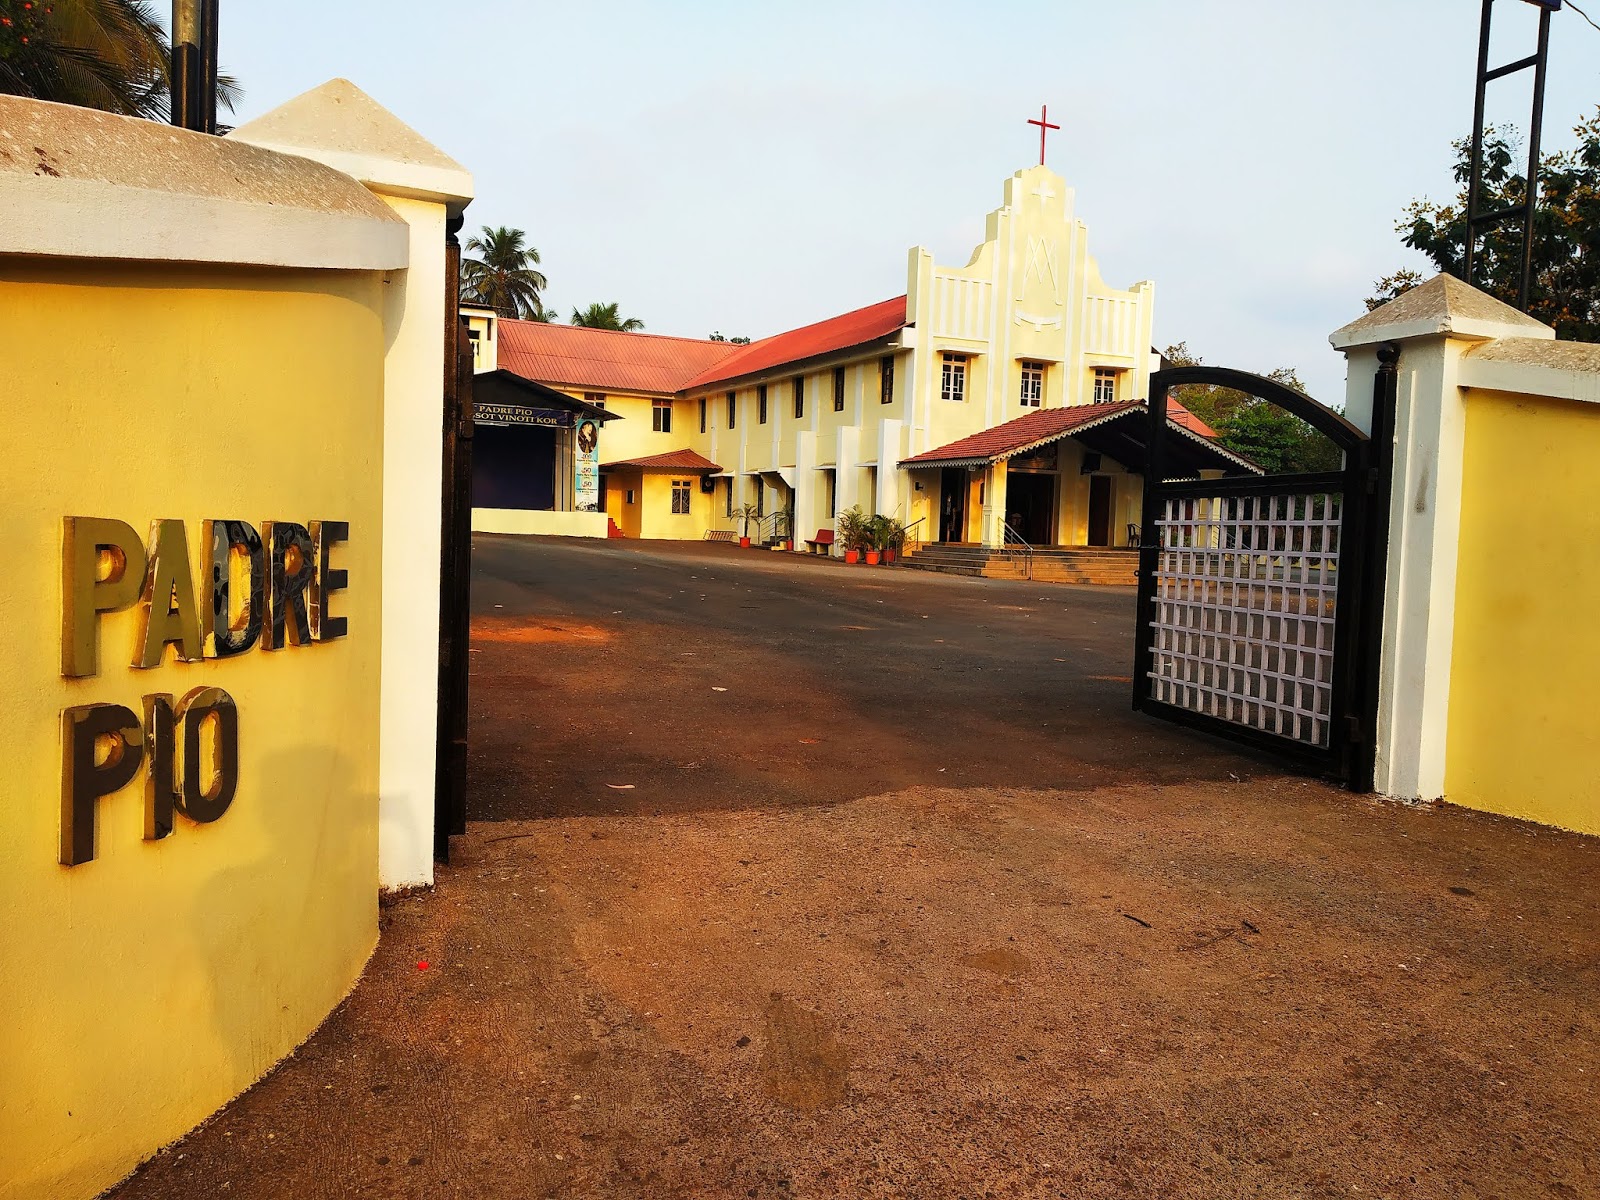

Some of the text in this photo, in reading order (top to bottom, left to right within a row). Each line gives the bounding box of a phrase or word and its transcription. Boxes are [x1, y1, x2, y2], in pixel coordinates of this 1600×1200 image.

[473, 412, 558, 425] SOT VINOTI KOR
[479, 405, 533, 416] PADRE PIO
[61, 516, 349, 677] PADRE
[58, 686, 238, 866] PIO
